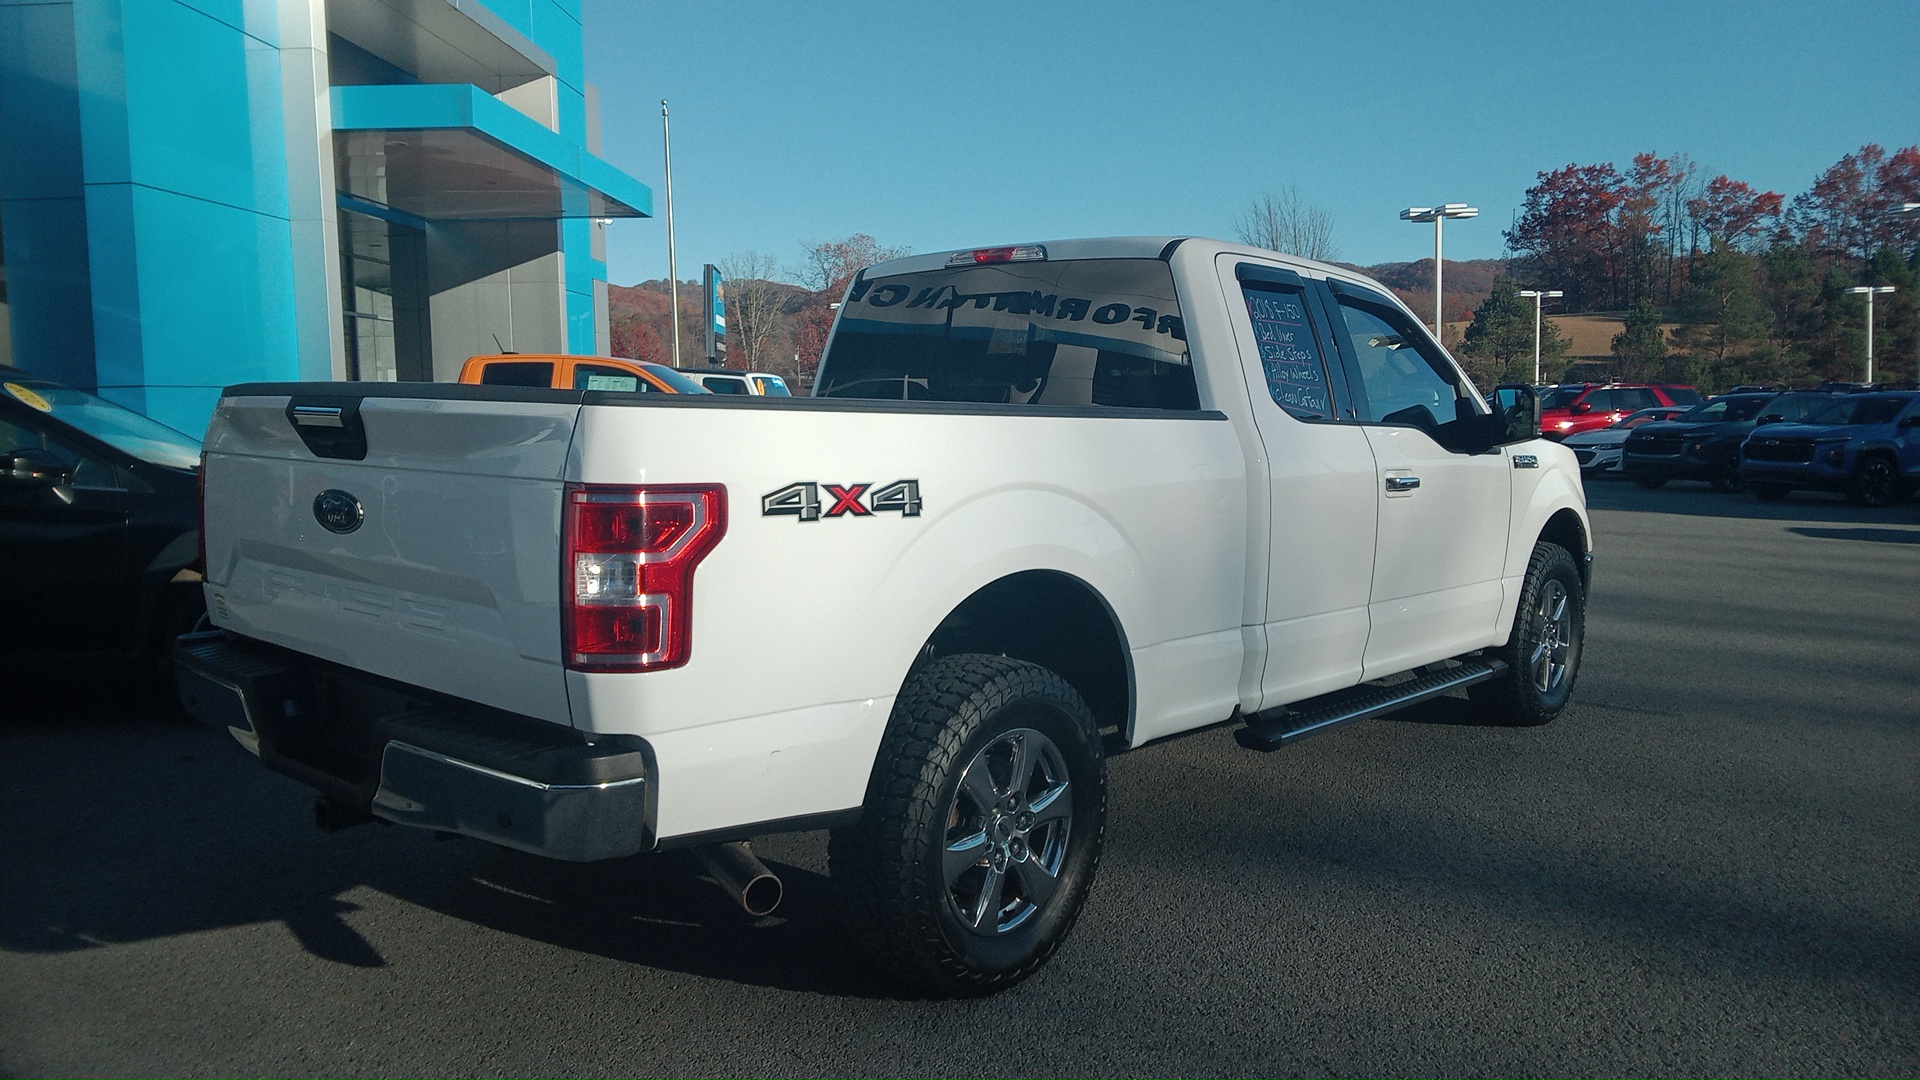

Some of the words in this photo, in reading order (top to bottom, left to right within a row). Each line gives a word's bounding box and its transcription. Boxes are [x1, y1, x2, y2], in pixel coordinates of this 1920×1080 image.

[1250, 296, 1275, 319] 2018
[1273, 301, 1301, 320] F-150
[1258, 322, 1277, 341] Bed
[1264, 345, 1287, 360] Side
[1287, 345, 1312, 366] Steps
[1271, 362, 1289, 382] Alloy
